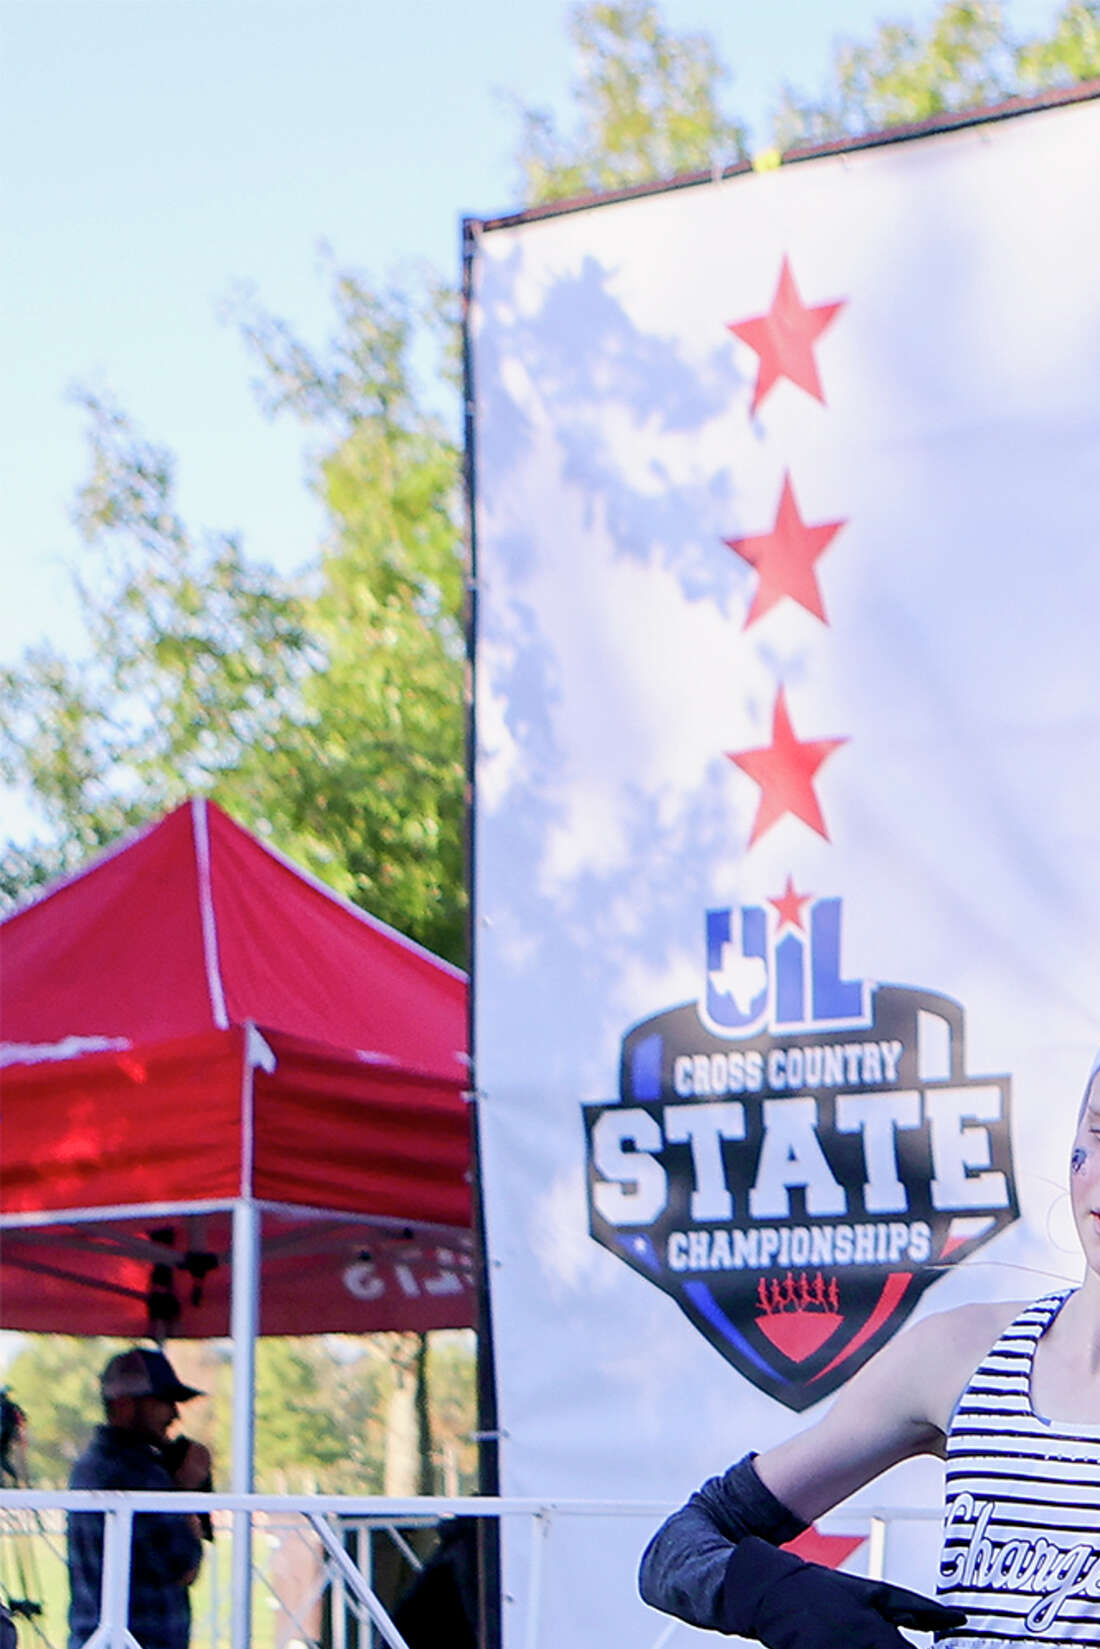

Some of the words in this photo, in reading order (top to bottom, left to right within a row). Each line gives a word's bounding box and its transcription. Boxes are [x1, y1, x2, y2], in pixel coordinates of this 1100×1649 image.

[705, 874, 864, 1029] UIL
[674, 1051, 764, 1097] CROSS
[767, 1040, 904, 1091] COUNTRY
[591, 1084, 1010, 1228] STATE
[668, 1221, 932, 1272] CHAMPIONSHIPS
